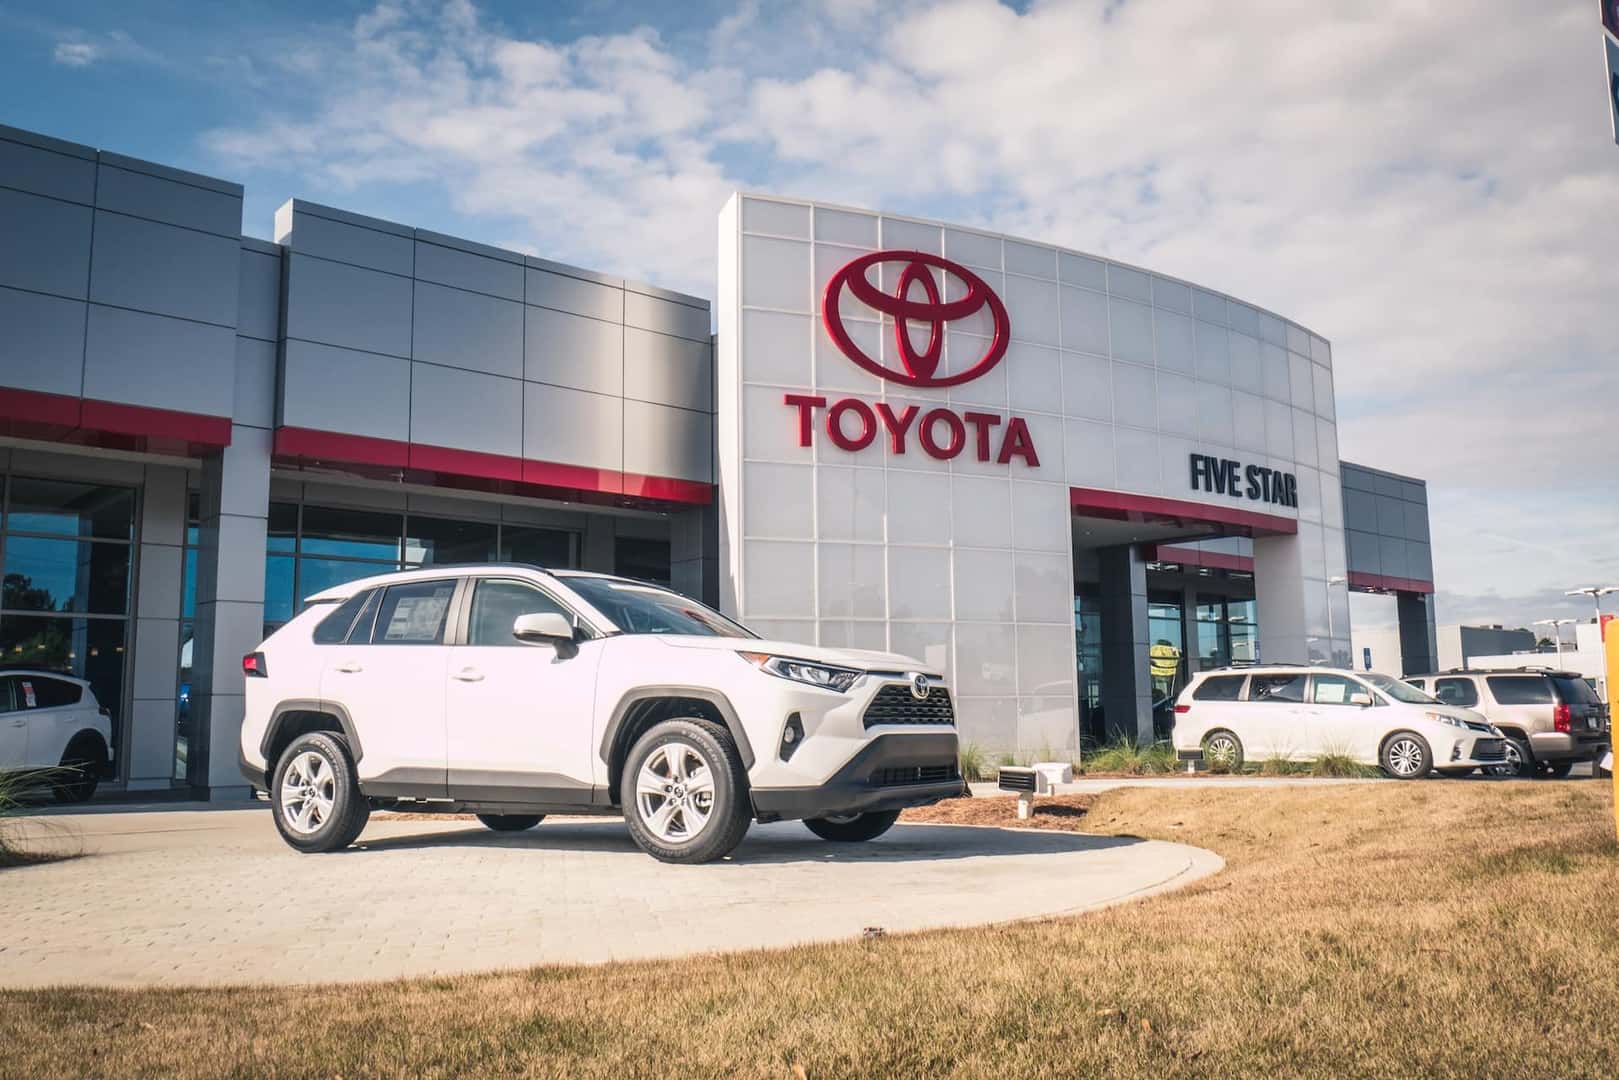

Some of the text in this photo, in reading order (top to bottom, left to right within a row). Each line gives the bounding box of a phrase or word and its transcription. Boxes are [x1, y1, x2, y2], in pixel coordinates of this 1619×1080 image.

[784, 394, 1040, 467] TOYOTA
[1190, 453, 1298, 508] FIVE STAR
